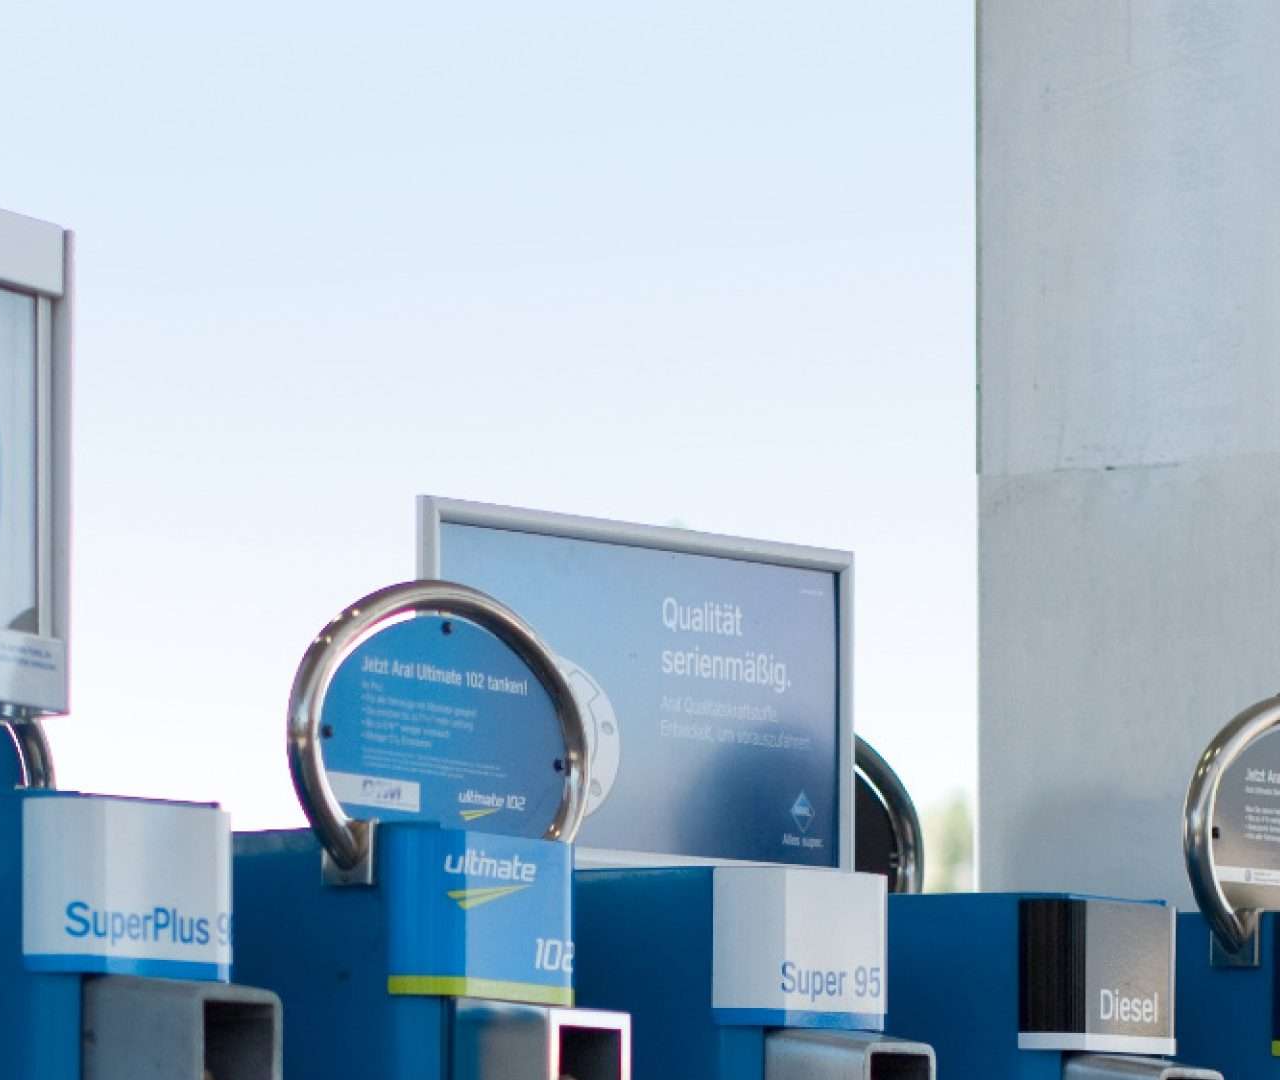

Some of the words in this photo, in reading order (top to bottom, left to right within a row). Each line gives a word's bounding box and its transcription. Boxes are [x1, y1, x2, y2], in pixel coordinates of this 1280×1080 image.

[662, 597, 743, 637] Qualität
[361, 655, 388, 676] Jetzt
[392, 660, 414, 680] Aral
[417, 663, 462, 688] Ultimate
[466, 671, 484, 690] 102
[488, 676, 528, 696] tanken!
[662, 646, 792, 694] serienmäßig.
[458, 788, 504, 808] ultimate
[506, 791, 526, 812] 102
[444, 848, 536, 883] ultimate
[64, 901, 210, 946] SuperPlus
[781, 961, 847, 1002] Super
[854, 966, 881, 998] 95
[1100, 990, 1158, 1025] Diesel
